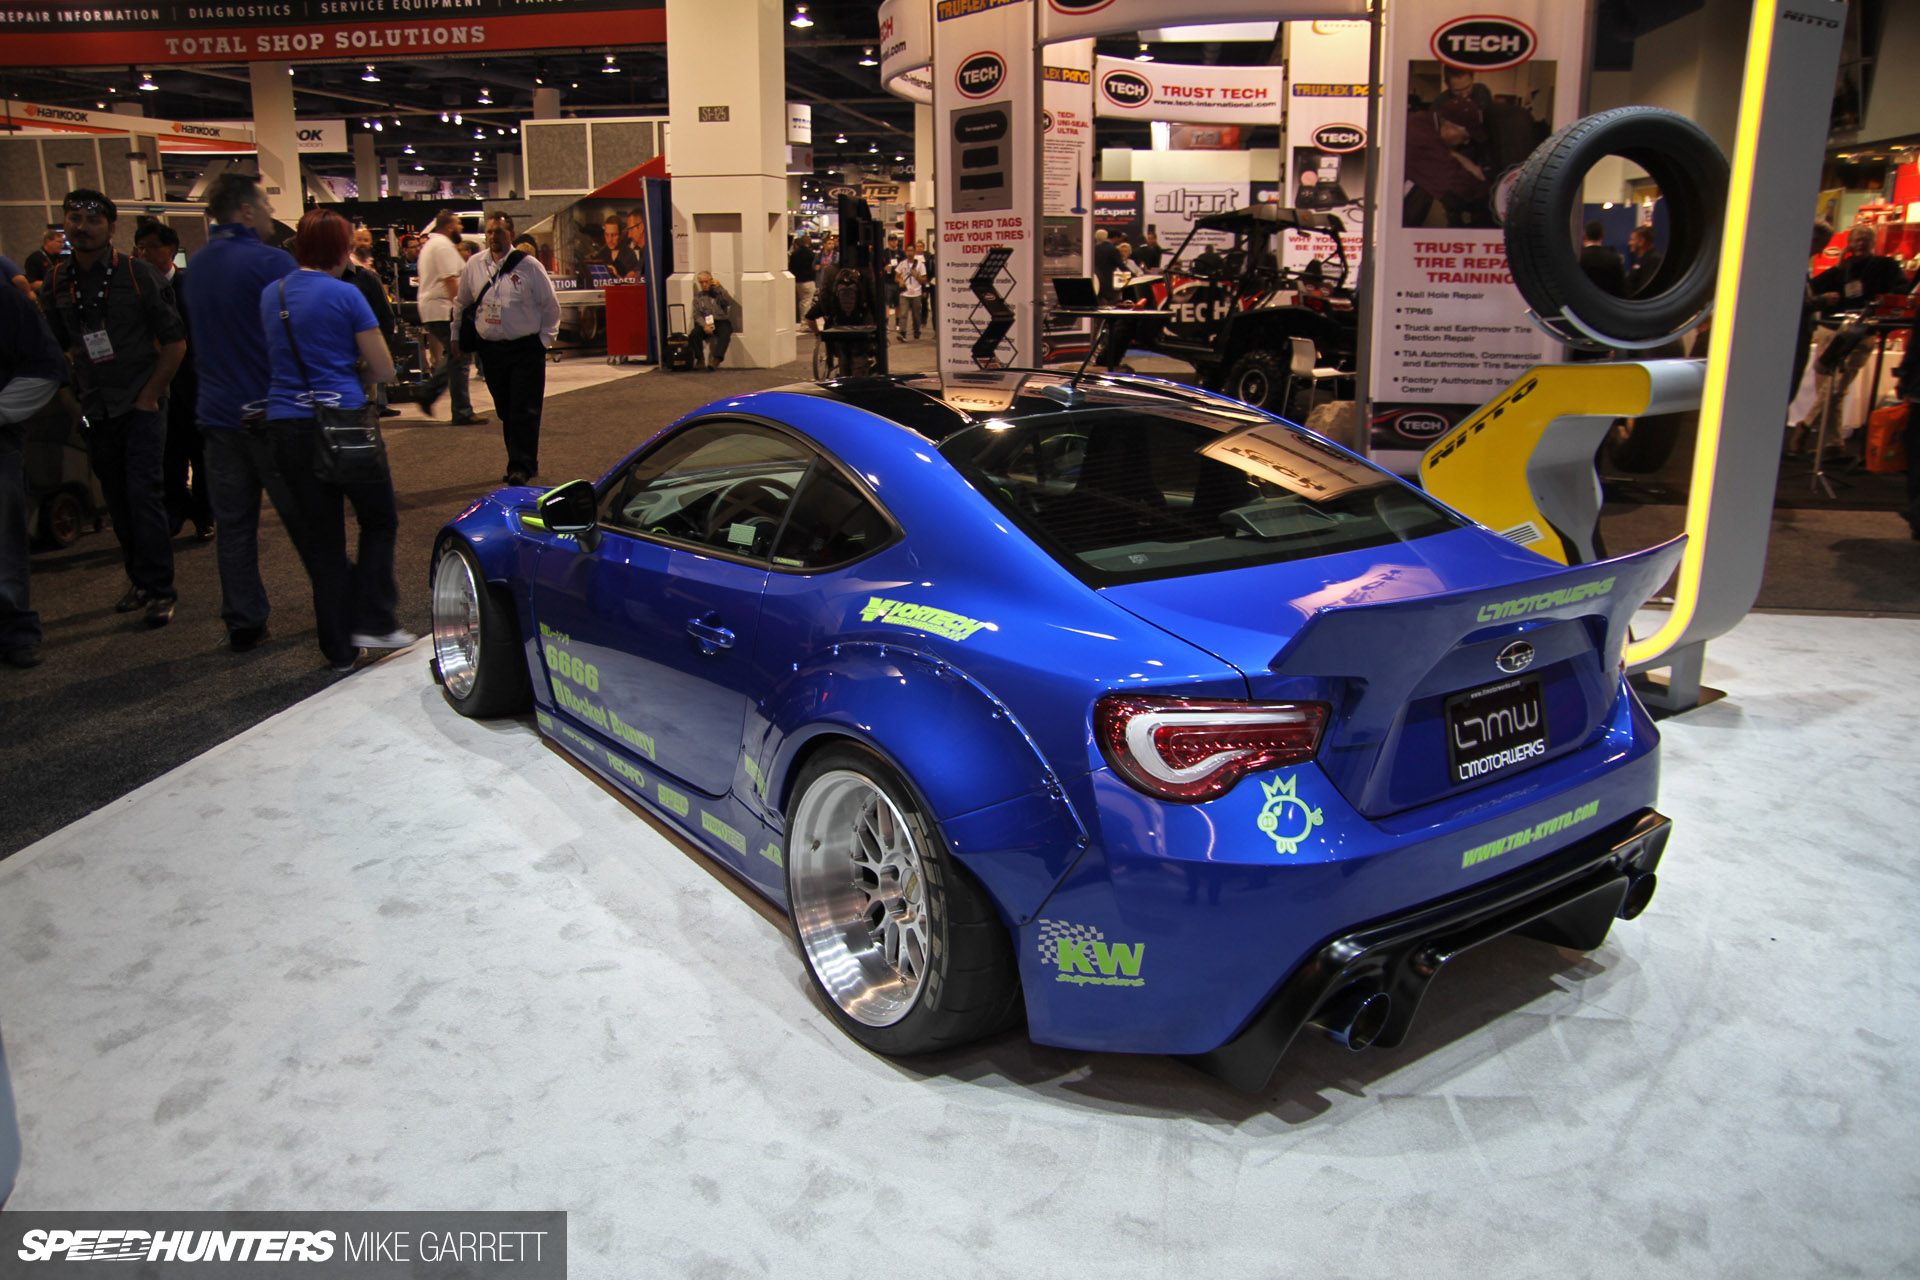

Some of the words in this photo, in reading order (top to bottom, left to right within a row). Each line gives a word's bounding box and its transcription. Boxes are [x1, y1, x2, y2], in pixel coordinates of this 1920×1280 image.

[0, 11, 50, 23] REPAIR
[57, 9, 160, 22] INFORMATION
[189, 5, 292, 19] DIAGNOSTICS
[321, 0, 386, 14] SERVICE
[165, 37, 247, 55] TOTAL
[256, 33, 325, 53] SHOP
[335, 26, 486, 49] SOLUTIONS
[1447, 35, 1520, 52] TECH
[963, 65, 999, 85] TECH
[1108, 80, 1145, 97] TECH
[1162, 85, 1215, 98] TRUST
[1221, 88, 1268, 99] TECH
[1295, 85, 1349, 96] TRUFLEX
[1320, 133, 1360, 143] TECH
[944, 220, 969, 231] TECH
[972, 219, 994, 230] RFID
[996, 217, 1022, 228] TAGS
[944, 233, 964, 243] GIVE
[967, 231, 993, 242] YOUR
[995, 230, 1024, 240] TIRES
[1413, 242, 1477, 254] TRUST
[1413, 257, 1457, 268] TIRE
[1405, 291, 1425, 299] Nail
[1453, 292, 1484, 300] Repair
[1169, 300, 1232, 322] TECH
[1404, 324, 1431, 332] Truck
[1433, 324, 1452, 332] and
[1455, 325, 1511, 333] Earthmover
[1404, 333, 1441, 341] Section
[1444, 334, 1476, 343] Repair
[1403, 350, 1418, 358] TIA
[1420, 350, 1478, 360] Automotive,
[1481, 352, 1542, 360] Commercial
[1402, 360, 1421, 368] and
[1424, 360, 1481, 369] Earthmover
[1483, 361, 1501, 369] Tire
[1401, 376, 1438, 385] Factory
[1441, 377, 1493, 386] Authorized
[1401, 385, 1434, 394] Center
[1403, 420, 1442, 430] TECH
[1430, 377, 1539, 469] NITTO
[890, 601, 985, 635] VORTECH
[546, 644, 599, 693] 6666
[563, 684, 610, 731] Rocket
[608, 708, 656, 761] Bunny
[1461, 799, 1600, 869] WWW.TRA-KYOTO.COM
[1057, 939, 1145, 976] KW
